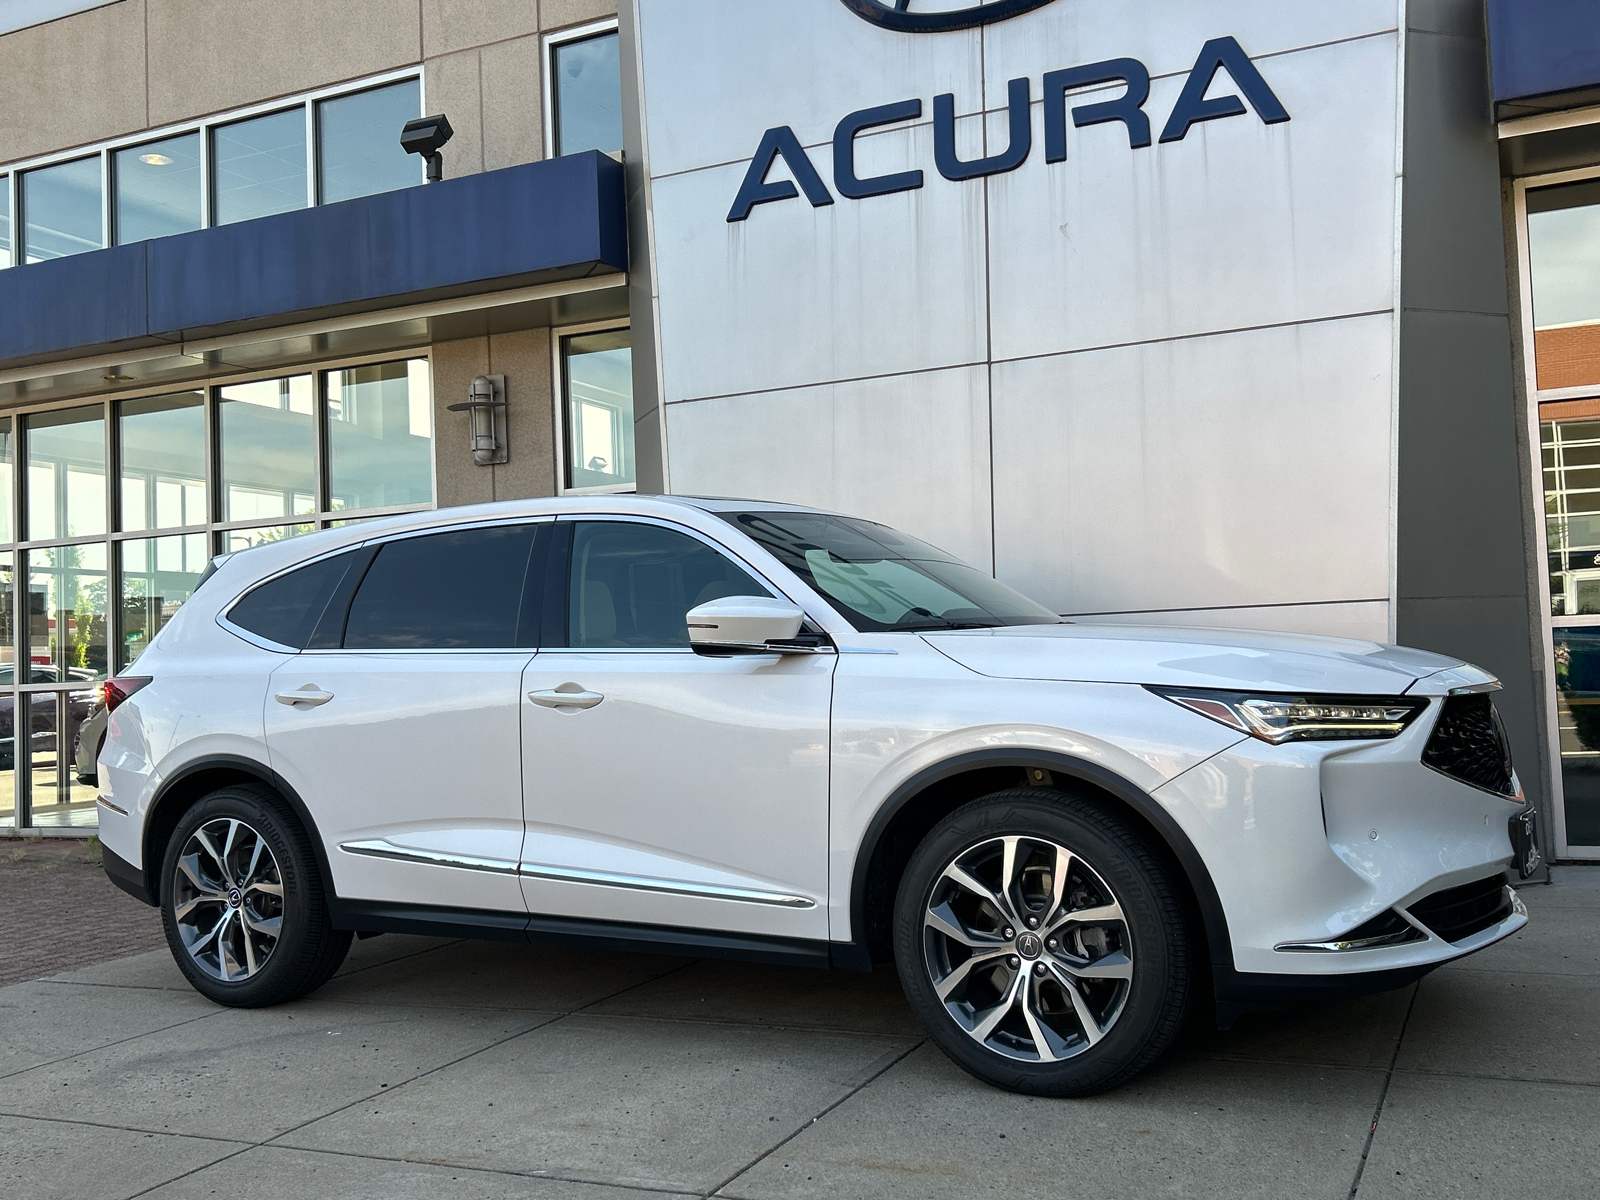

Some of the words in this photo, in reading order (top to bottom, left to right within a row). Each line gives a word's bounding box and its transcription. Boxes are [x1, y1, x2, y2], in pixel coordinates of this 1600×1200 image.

[726, 35, 1291, 223] ACURA
[256, 812, 298, 898] BRIDGESTONE
[1108, 852, 1163, 987] BRIDGESTONE
